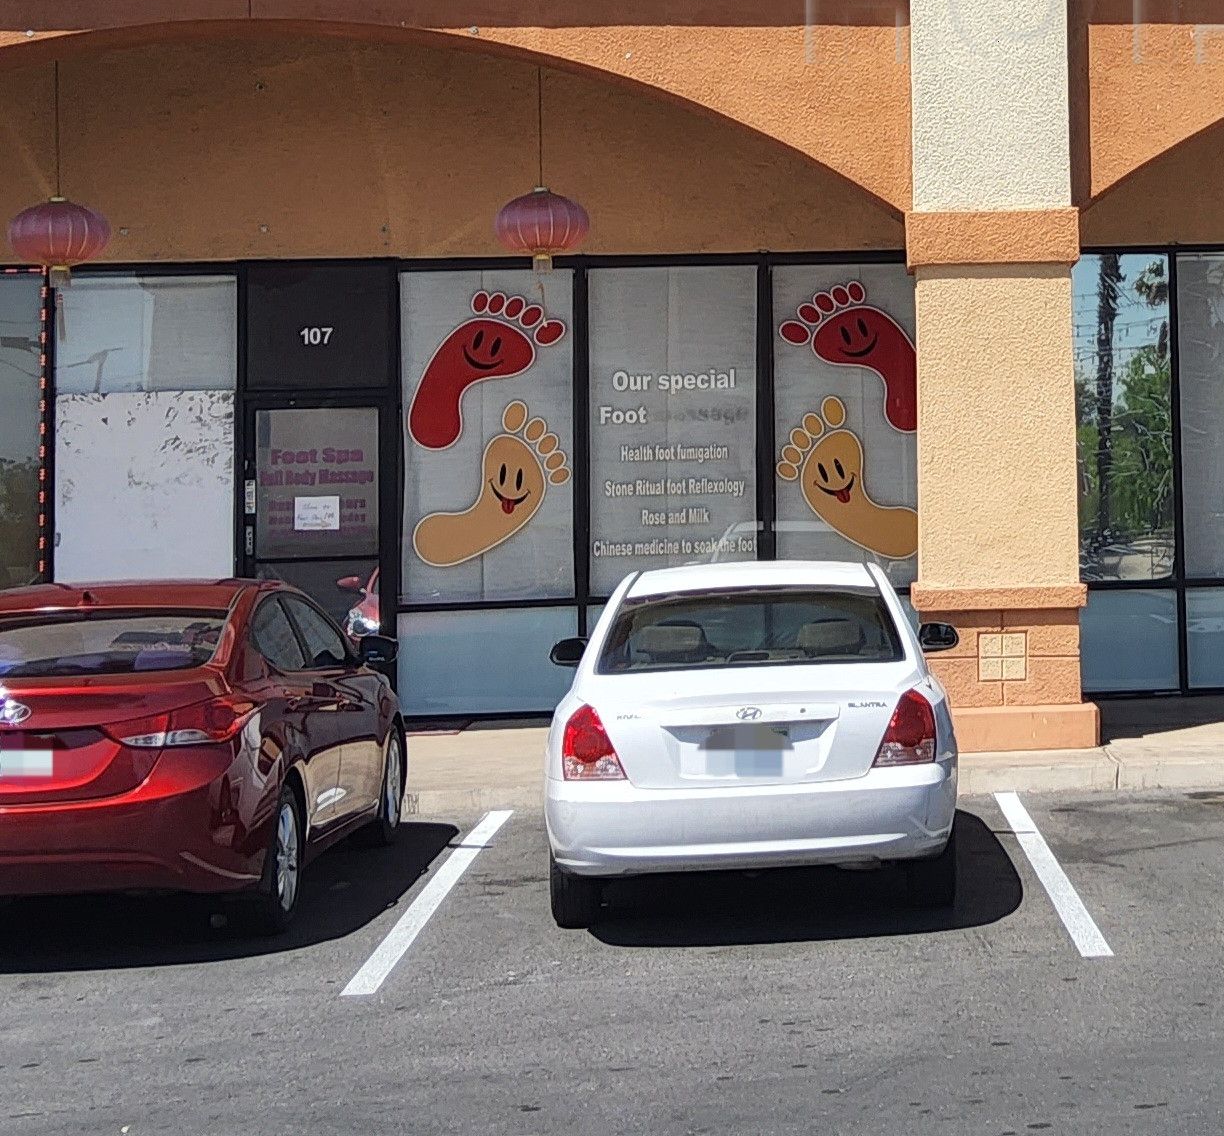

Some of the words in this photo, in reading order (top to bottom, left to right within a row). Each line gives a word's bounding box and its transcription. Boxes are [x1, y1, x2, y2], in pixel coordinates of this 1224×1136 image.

[300, 327, 333, 345] 107
[612, 370, 651, 391] Our
[658, 368, 736, 395] special
[600, 406, 647, 424] Foot
[271, 448, 318, 465] Foot
[621, 445, 653, 462] Health
[655, 444, 674, 460] foot
[677, 444, 728, 463] fumigation
[605, 480, 634, 496] Stone
[635, 479, 664, 495] Ritual
[667, 478, 686, 495] foot
[689, 477, 745, 497] Reflexology
[641, 509, 665, 525] Rose
[668, 509, 686, 524] and
[689, 508, 710, 523] Milk
[593, 540, 632, 556] Chinese
[635, 539, 679, 555] medicine
[682, 539, 691, 554] to
[694, 538, 716, 554] soak
[718, 537, 735, 552] the
